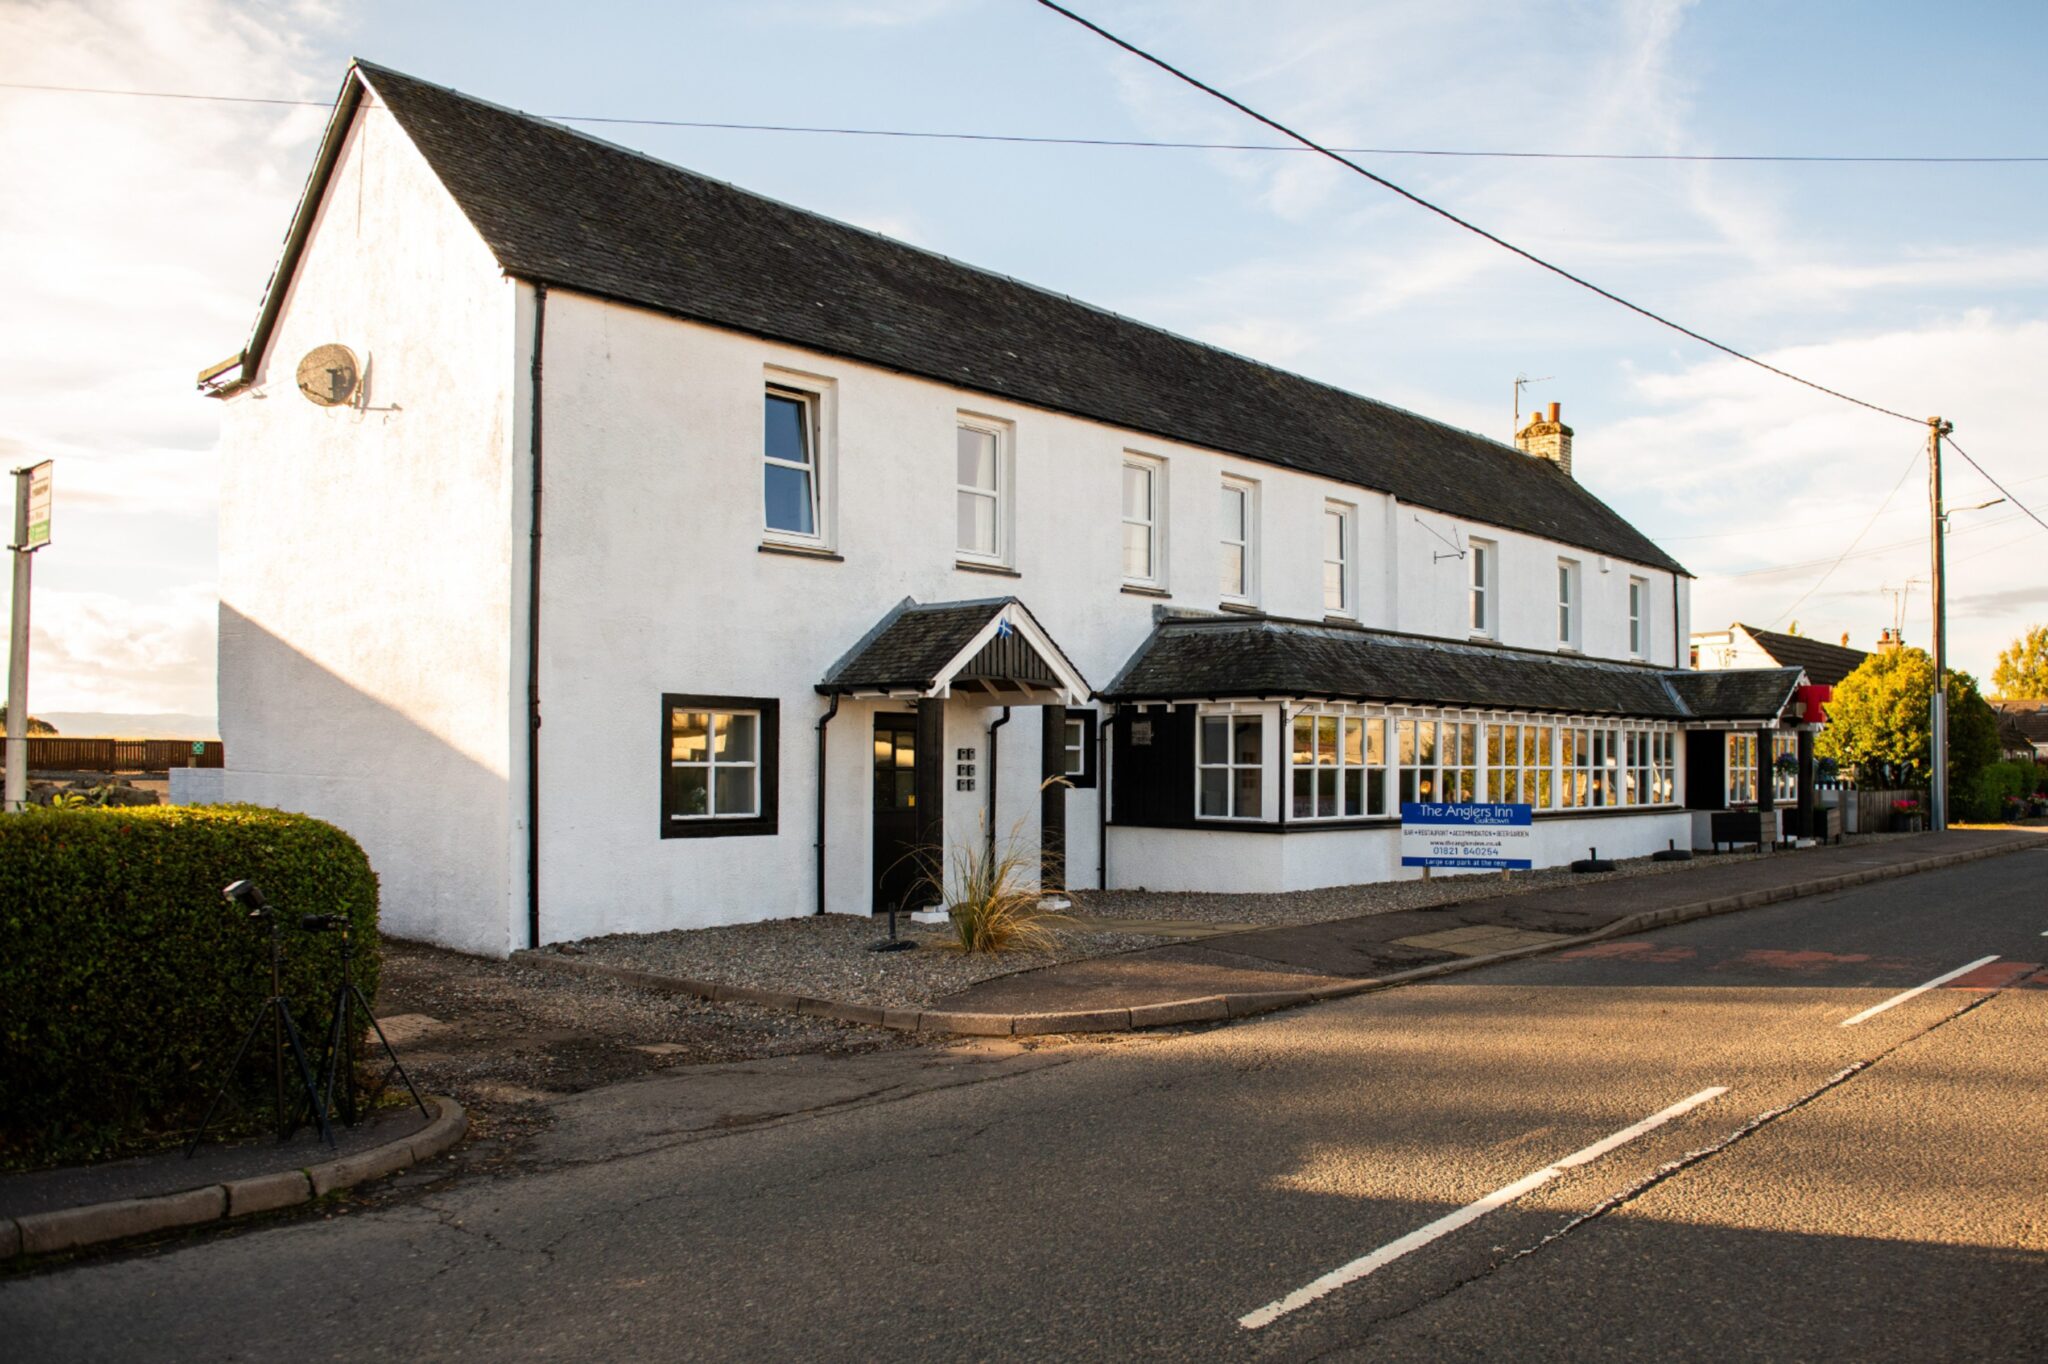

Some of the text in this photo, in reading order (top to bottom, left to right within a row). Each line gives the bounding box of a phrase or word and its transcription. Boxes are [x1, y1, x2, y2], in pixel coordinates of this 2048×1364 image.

[1420, 804, 1513, 820] The Anglers Inn
[1474, 816, 1509, 824] Guildtown
[1433, 847, 1498, 856] 01821 640254
[1456, 859, 1471, 867] park
